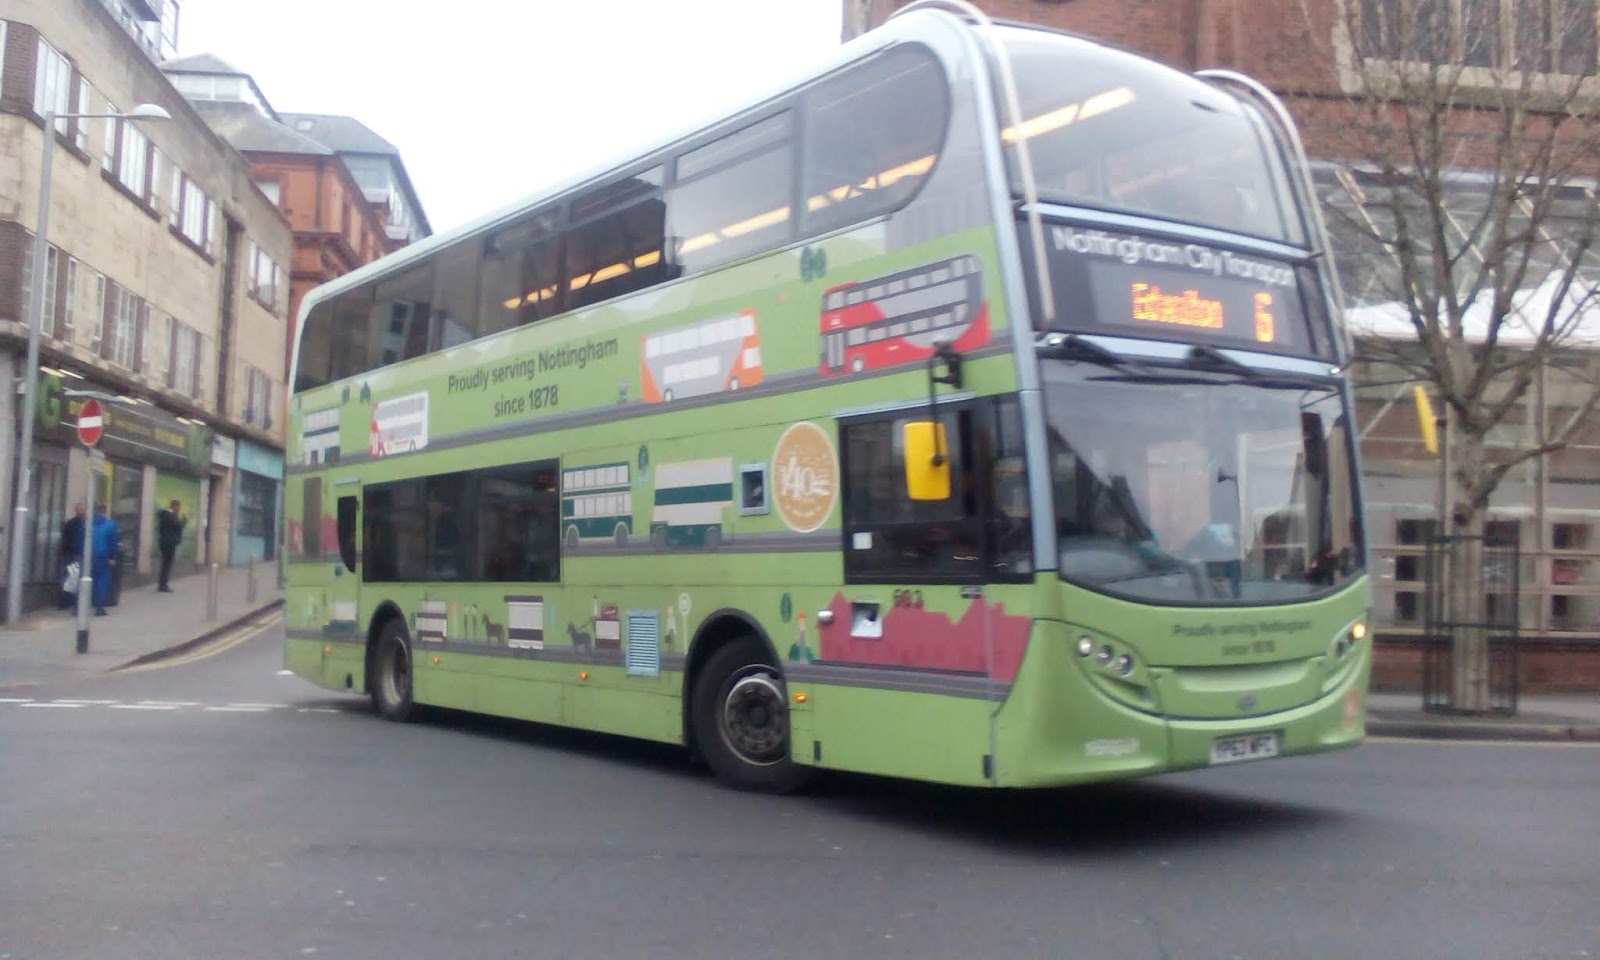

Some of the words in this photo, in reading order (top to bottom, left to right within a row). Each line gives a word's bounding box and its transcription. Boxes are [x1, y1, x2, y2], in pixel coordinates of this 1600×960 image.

[1051, 226, 1185, 264] Nottingham
[1184, 243, 1222, 276] City
[1254, 292, 1274, 342] 6
[448, 368, 490, 395] Proudly
[492, 358, 536, 384] serving
[538, 338, 618, 371] Nottingham
[494, 394, 525, 417] since
[528, 385, 558, 410] 1878
